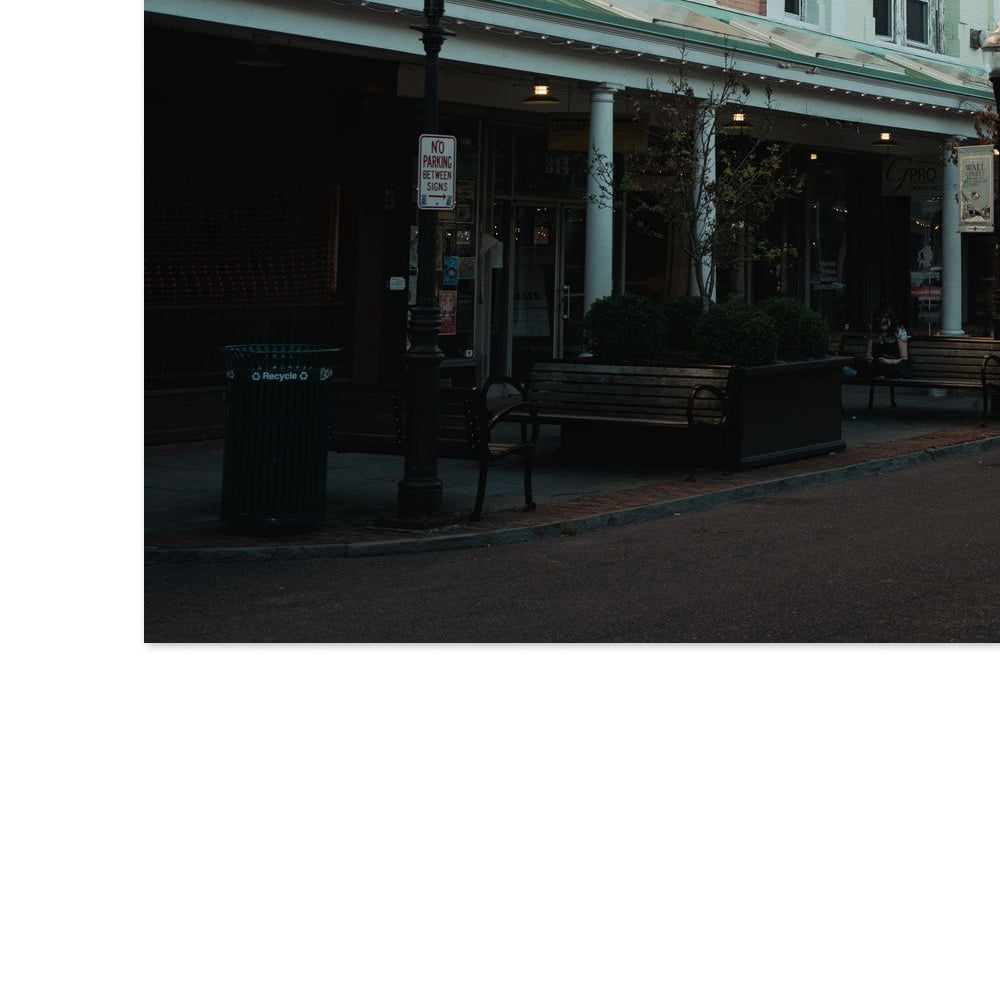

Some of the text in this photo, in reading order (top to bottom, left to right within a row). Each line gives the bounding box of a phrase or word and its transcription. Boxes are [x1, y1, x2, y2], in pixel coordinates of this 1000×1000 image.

[431, 141, 445, 154] NO
[423, 155, 452, 169] PARKING
[965, 163, 985, 171] WALL
[423, 170, 452, 180] BETWEEN
[426, 182, 448, 192] SIGNS
[262, 371, 297, 382] Recycle
